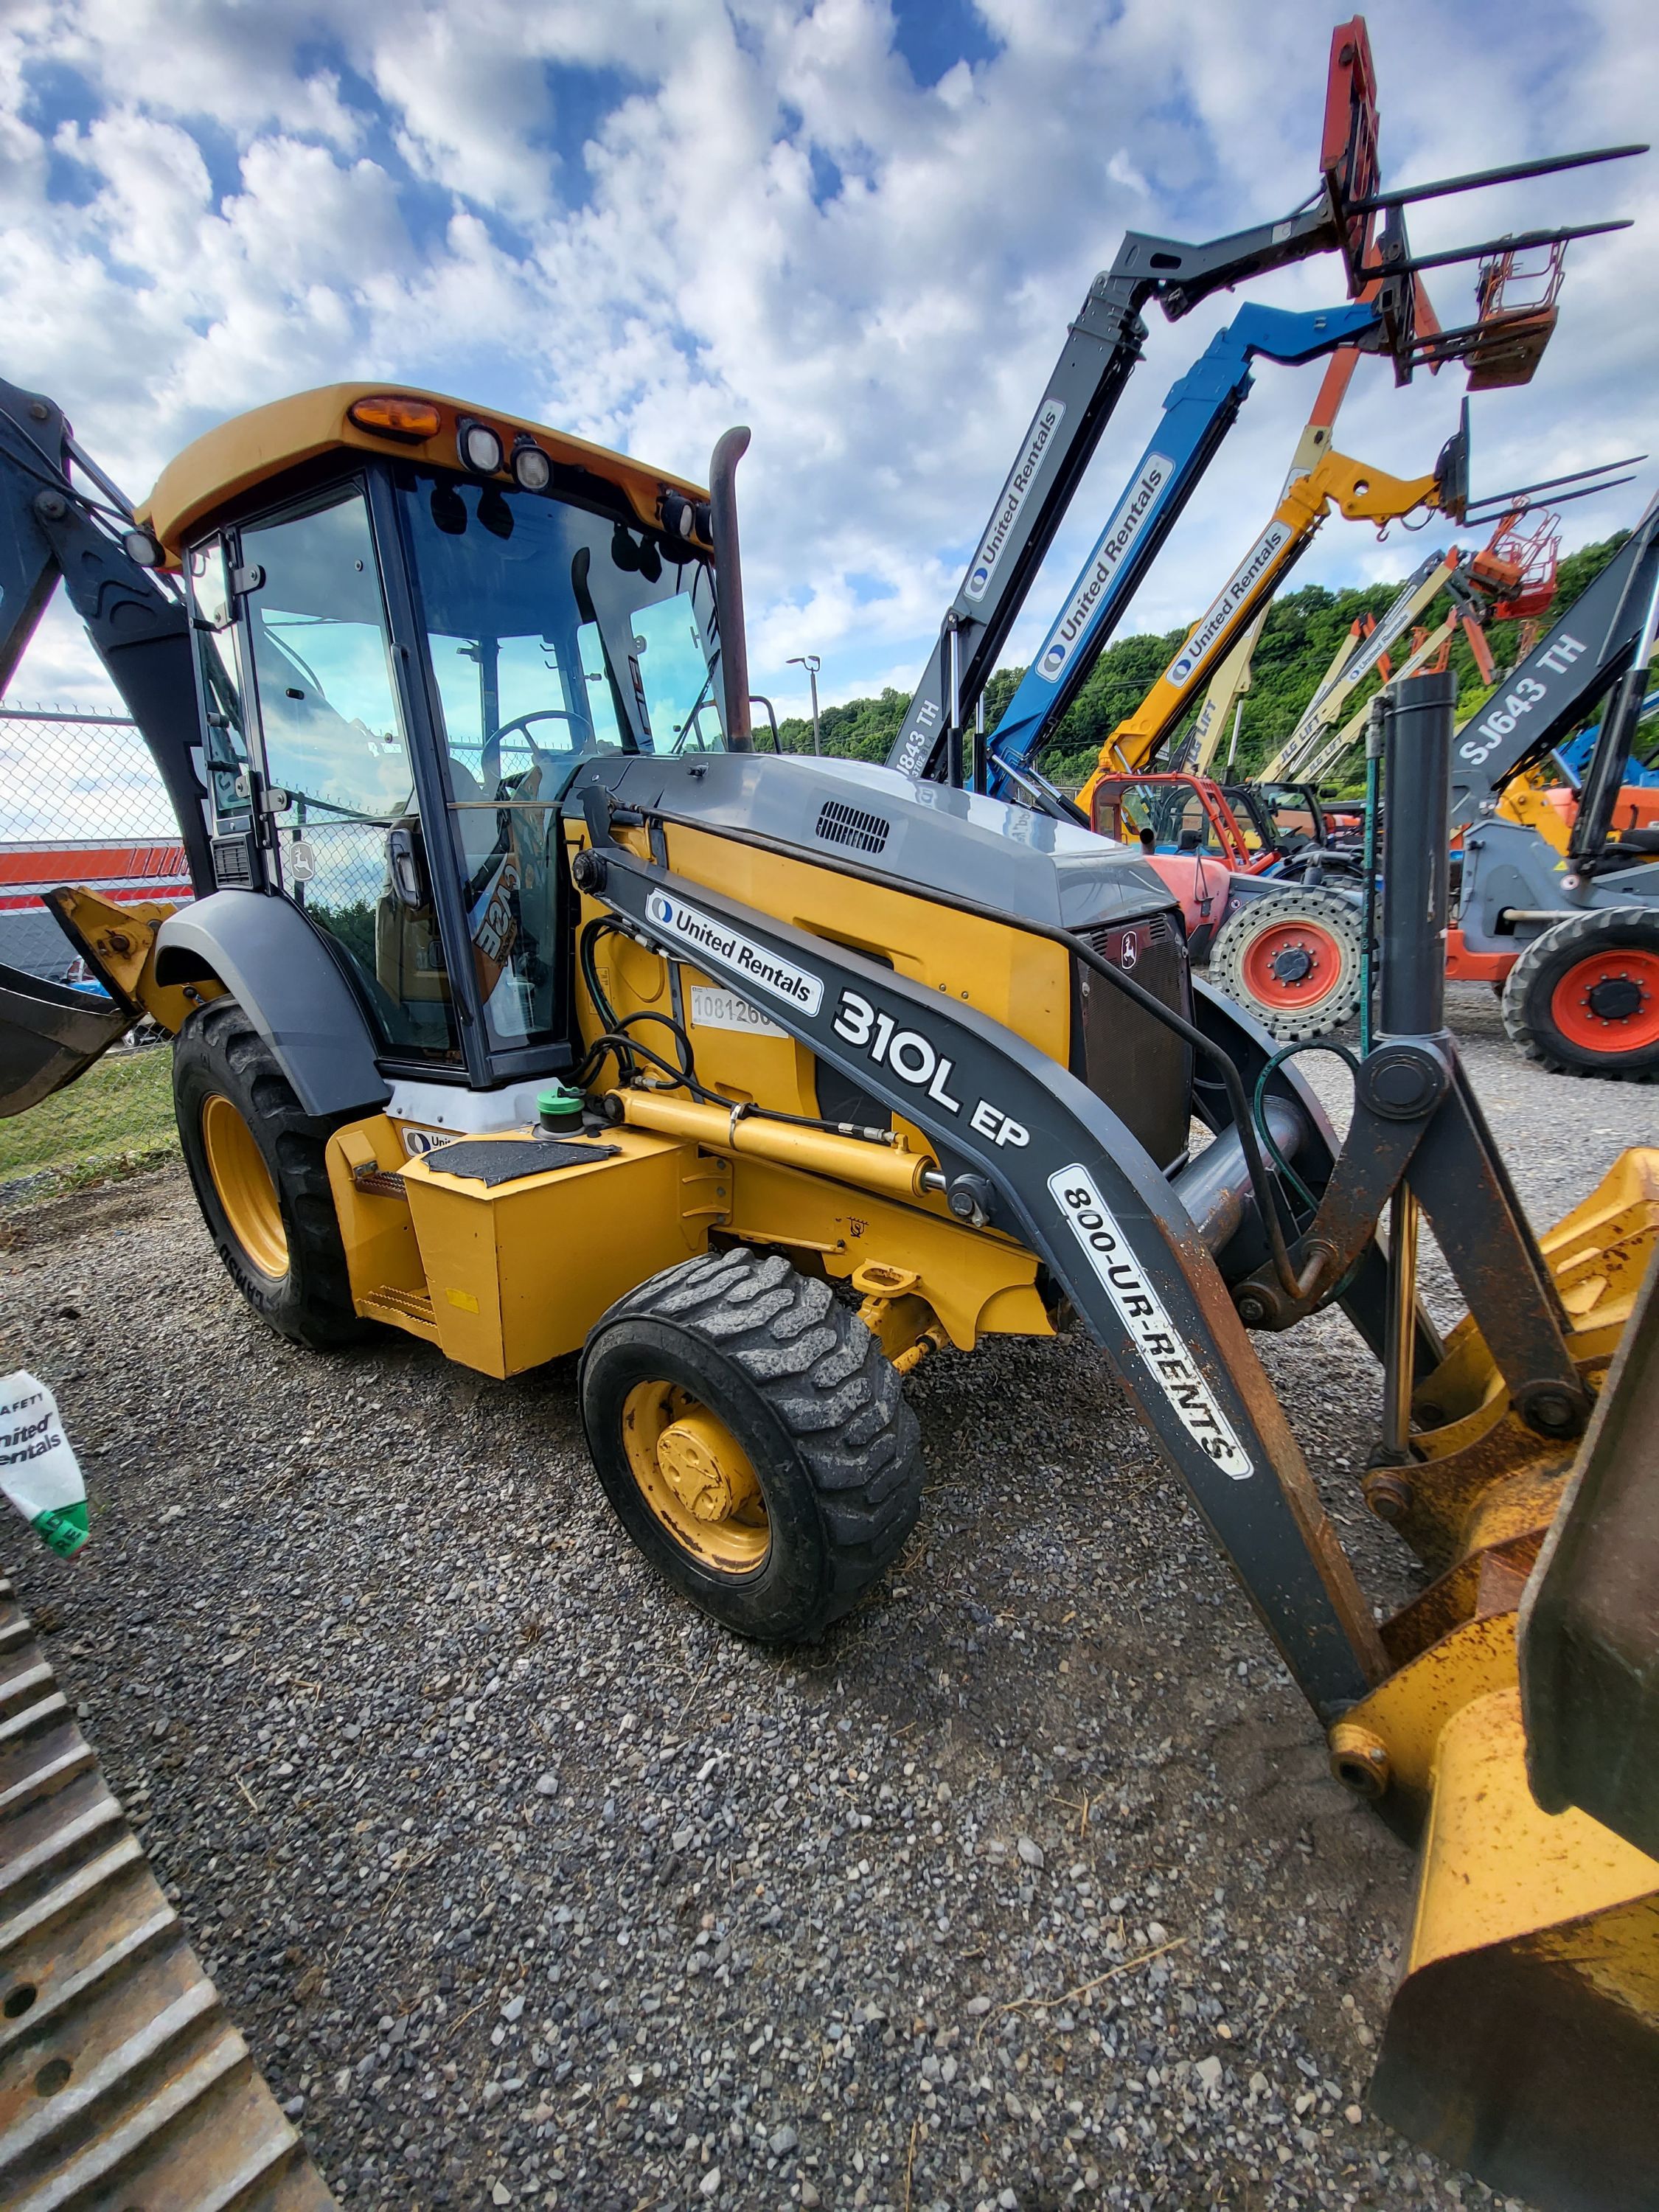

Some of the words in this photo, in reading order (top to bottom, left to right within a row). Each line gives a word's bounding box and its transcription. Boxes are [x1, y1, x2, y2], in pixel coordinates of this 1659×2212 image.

[982, 493, 1019, 564] United
[1013, 410, 1056, 493] Rentals
[1060, 562, 1110, 641] United
[1105, 468, 1162, 563] Rentals
[1189, 598, 1234, 658] United
[1230, 532, 1282, 600] Rentals
[896, 730, 925, 776] J843
[916, 700, 939, 727] TH
[1196, 698, 1217, 737] LIFT
[1281, 740, 1298, 764] JLG
[1298, 714, 1320, 742] LIFT
[1458, 677, 1548, 765] SJ643
[1535, 633, 1587, 675] TH
[1310, 756, 1323, 774] JLG
[1324, 734, 1342, 757] LIFT
[676, 910, 736, 959] United
[737, 945, 811, 1002] Rentals
[833, 991, 960, 1113] 310L
[970, 1099, 1031, 1147] EP
[1063, 1187, 1234, 1460] 800-UR-RENTS
[0, 1392, 43, 1416] AFETY
[0, 1411, 53, 1447] nited
[0, 1434, 61, 1466] entals
